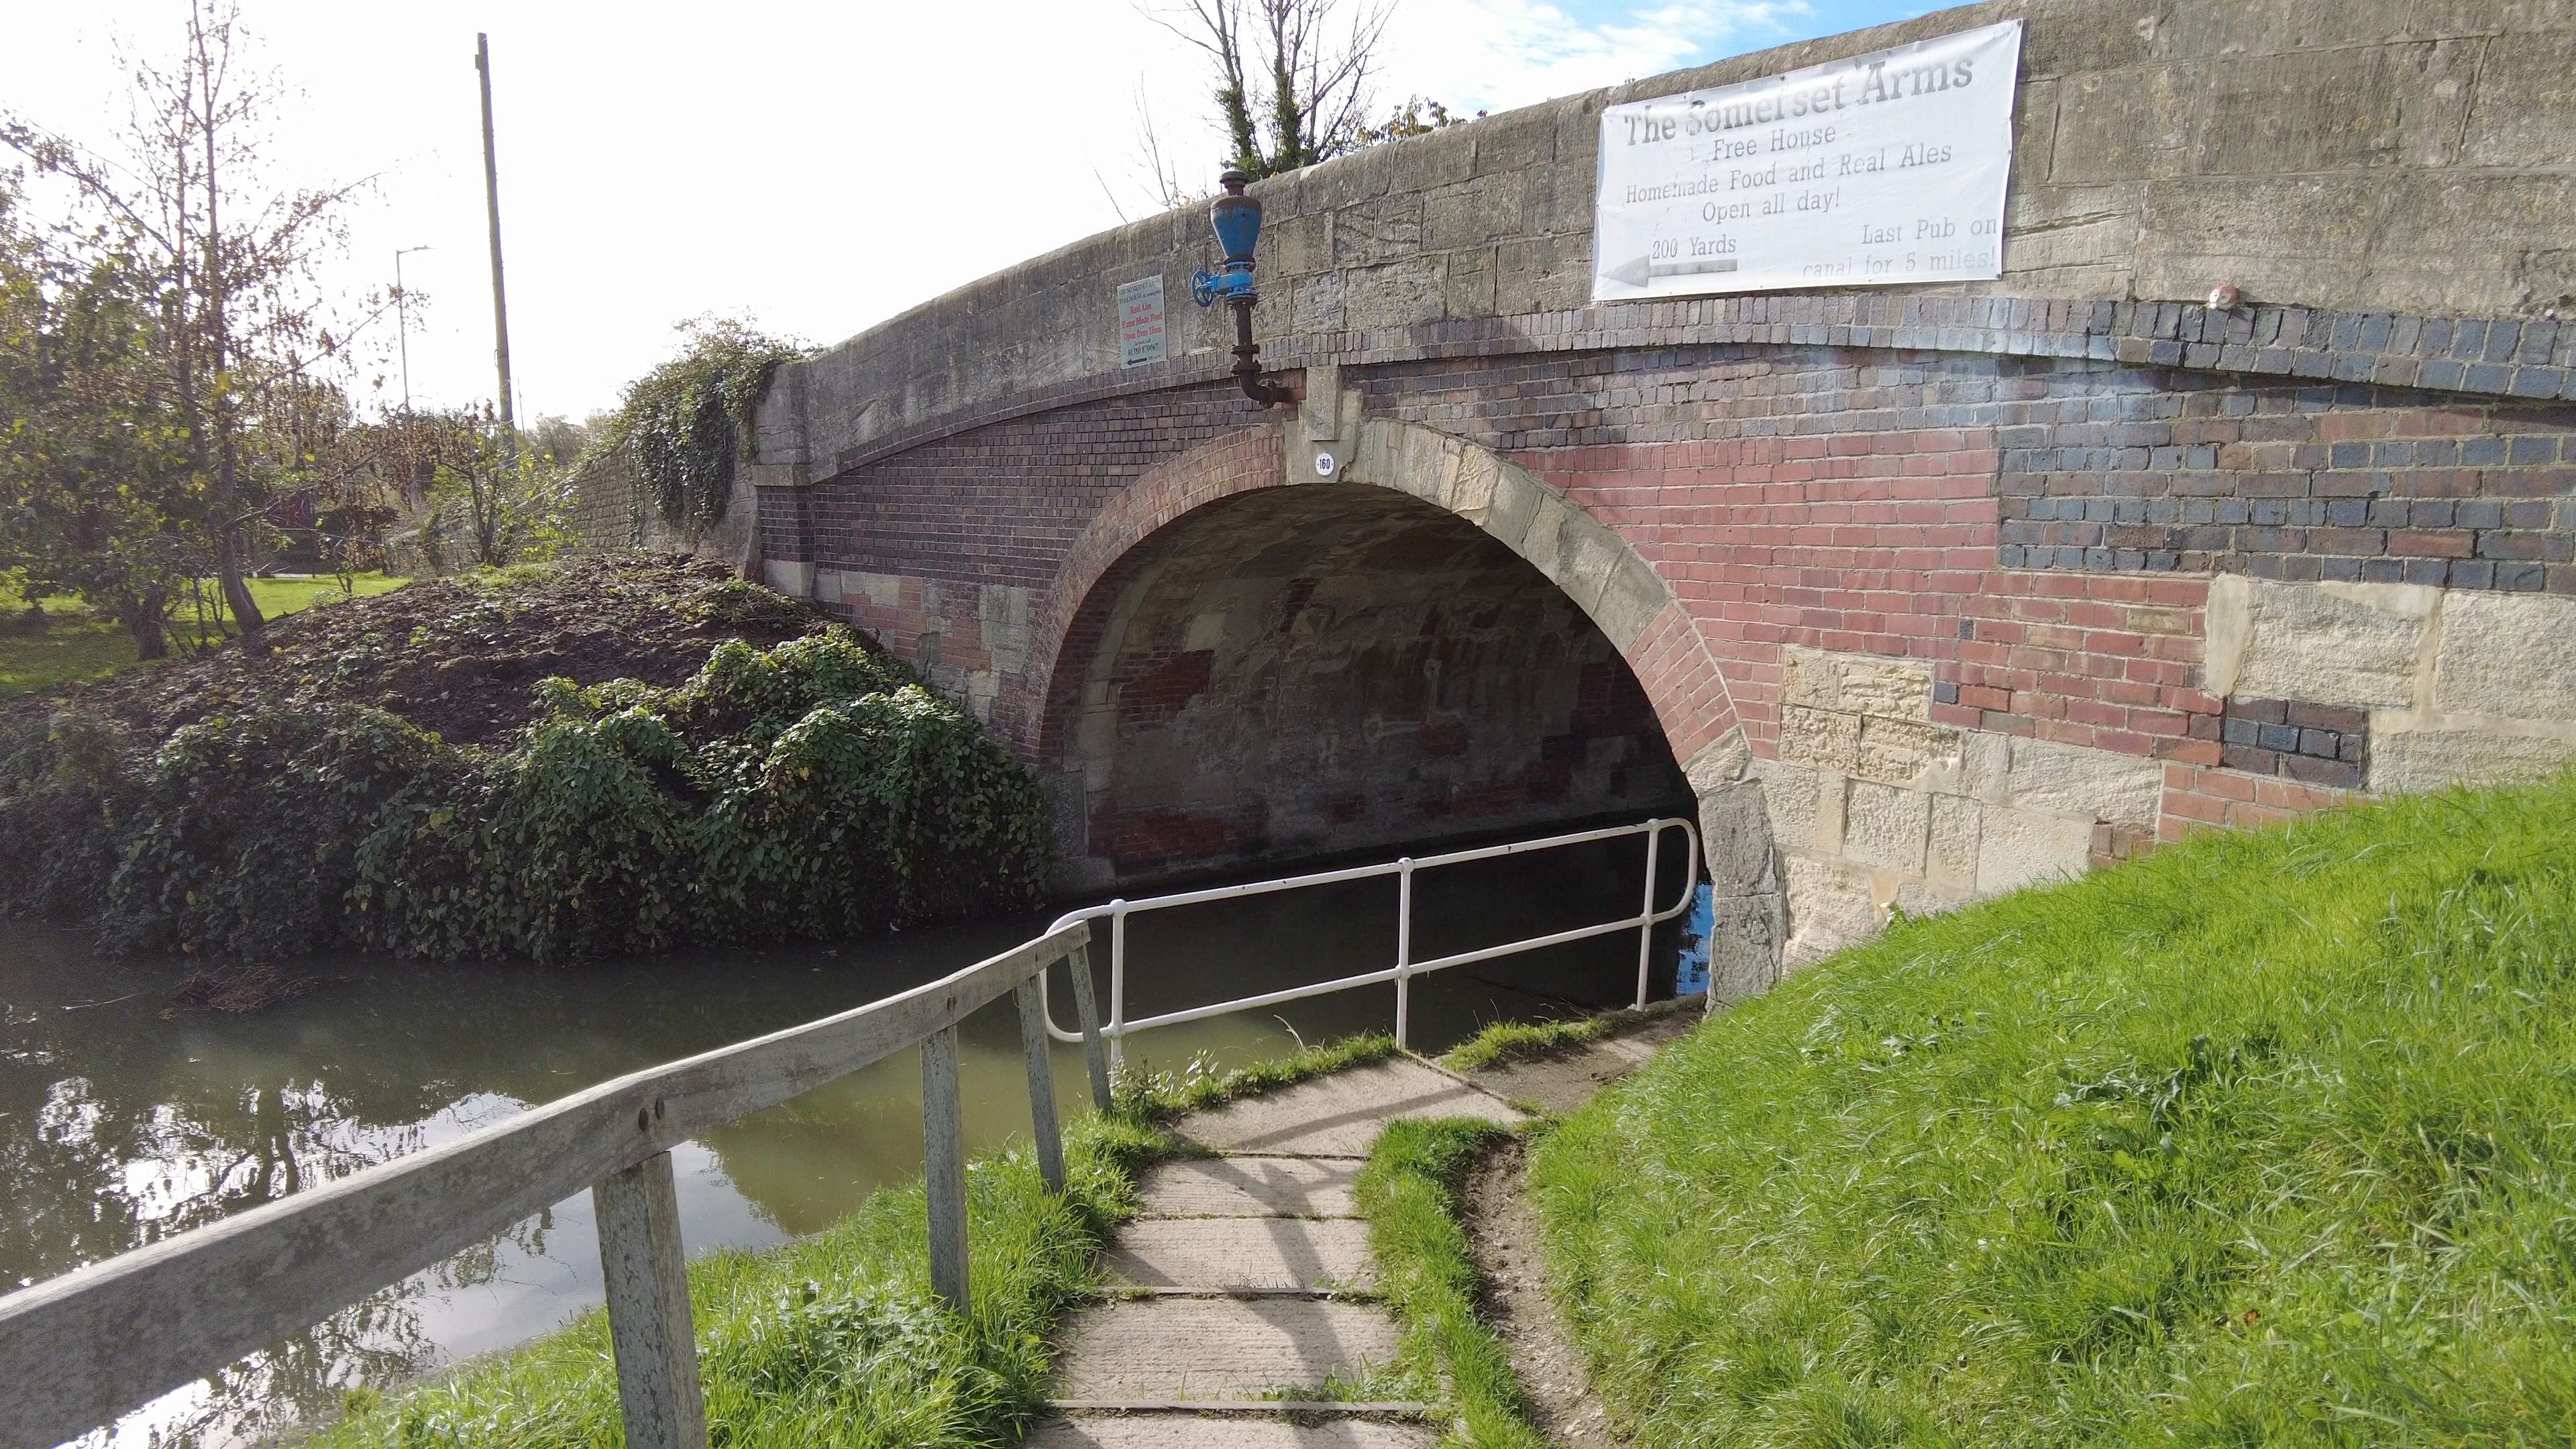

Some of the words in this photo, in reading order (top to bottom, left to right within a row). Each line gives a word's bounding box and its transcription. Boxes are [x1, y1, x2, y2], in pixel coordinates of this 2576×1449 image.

[1624, 105, 1676, 146] The
[1686, 75, 1846, 136] Somerset
[1857, 58, 1973, 105] Arms
[1712, 138, 1757, 161] Free
[1770, 125, 1836, 152] House
[1729, 161, 1776, 191] Food
[1789, 157, 1825, 182] and
[1838, 148, 1885, 176] Real
[1899, 142, 1951, 168] Ales
[1703, 201, 1751, 224] Open
[1762, 193, 1785, 215] all
[1797, 186, 1841, 213] day!
[1862, 224, 1902, 244] Last
[1915, 217, 1955, 240] Pub
[1970, 218, 1997, 235] on
[1652, 238, 1678, 260] 200
[1689, 234, 1737, 256] Yards
[1803, 256, 1852, 278] canal
[1865, 254, 1893, 274] for
[1906, 252, 1916, 271] 5
[1929, 246, 1996, 271] miles!
[1130, 304, 1140, 314] Real
[1142, 302, 1152, 311] Ales
[1136, 315, 1149, 325] Made
[1124, 333, 1136, 341] Open
[1320, 458, 1330, 470] 160
